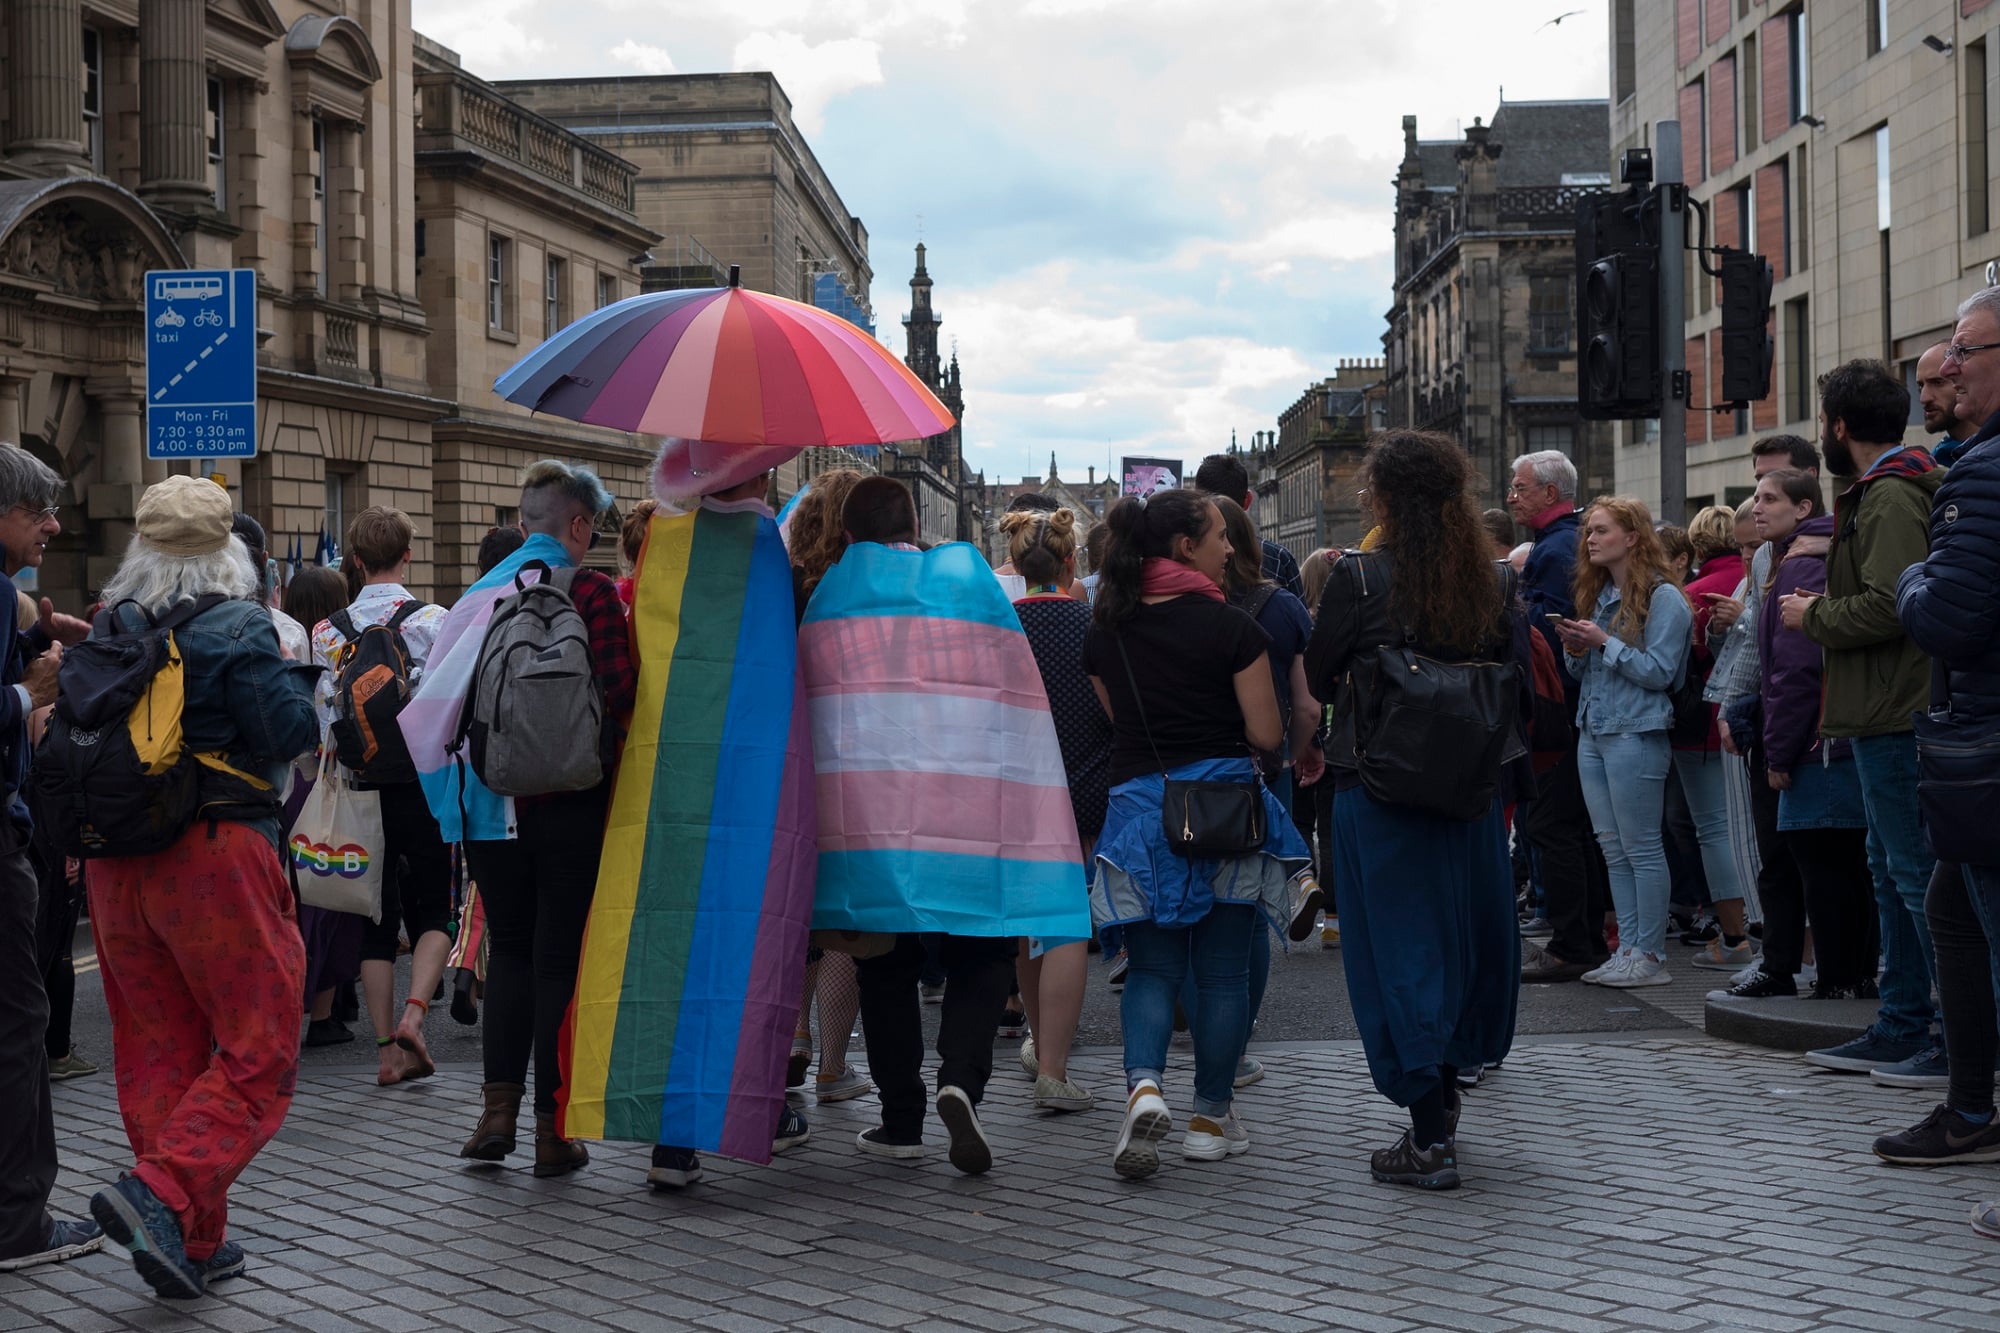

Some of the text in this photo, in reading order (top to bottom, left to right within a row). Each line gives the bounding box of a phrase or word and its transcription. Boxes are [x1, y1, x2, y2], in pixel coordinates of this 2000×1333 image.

[156, 331, 179, 343] taxi
[175, 410, 202, 422] Mon
[212, 409, 229, 421] Fri
[157, 426, 186, 438] 7.30
[195, 425, 225, 437] 9.30
[226, 427, 246, 437] am
[156, 440, 187, 452] 4.00
[196, 439, 226, 451] 6.30
[228, 441, 247, 453] pm
[1124, 473, 1137, 482] BE
[296, 840, 361, 872] TSB
